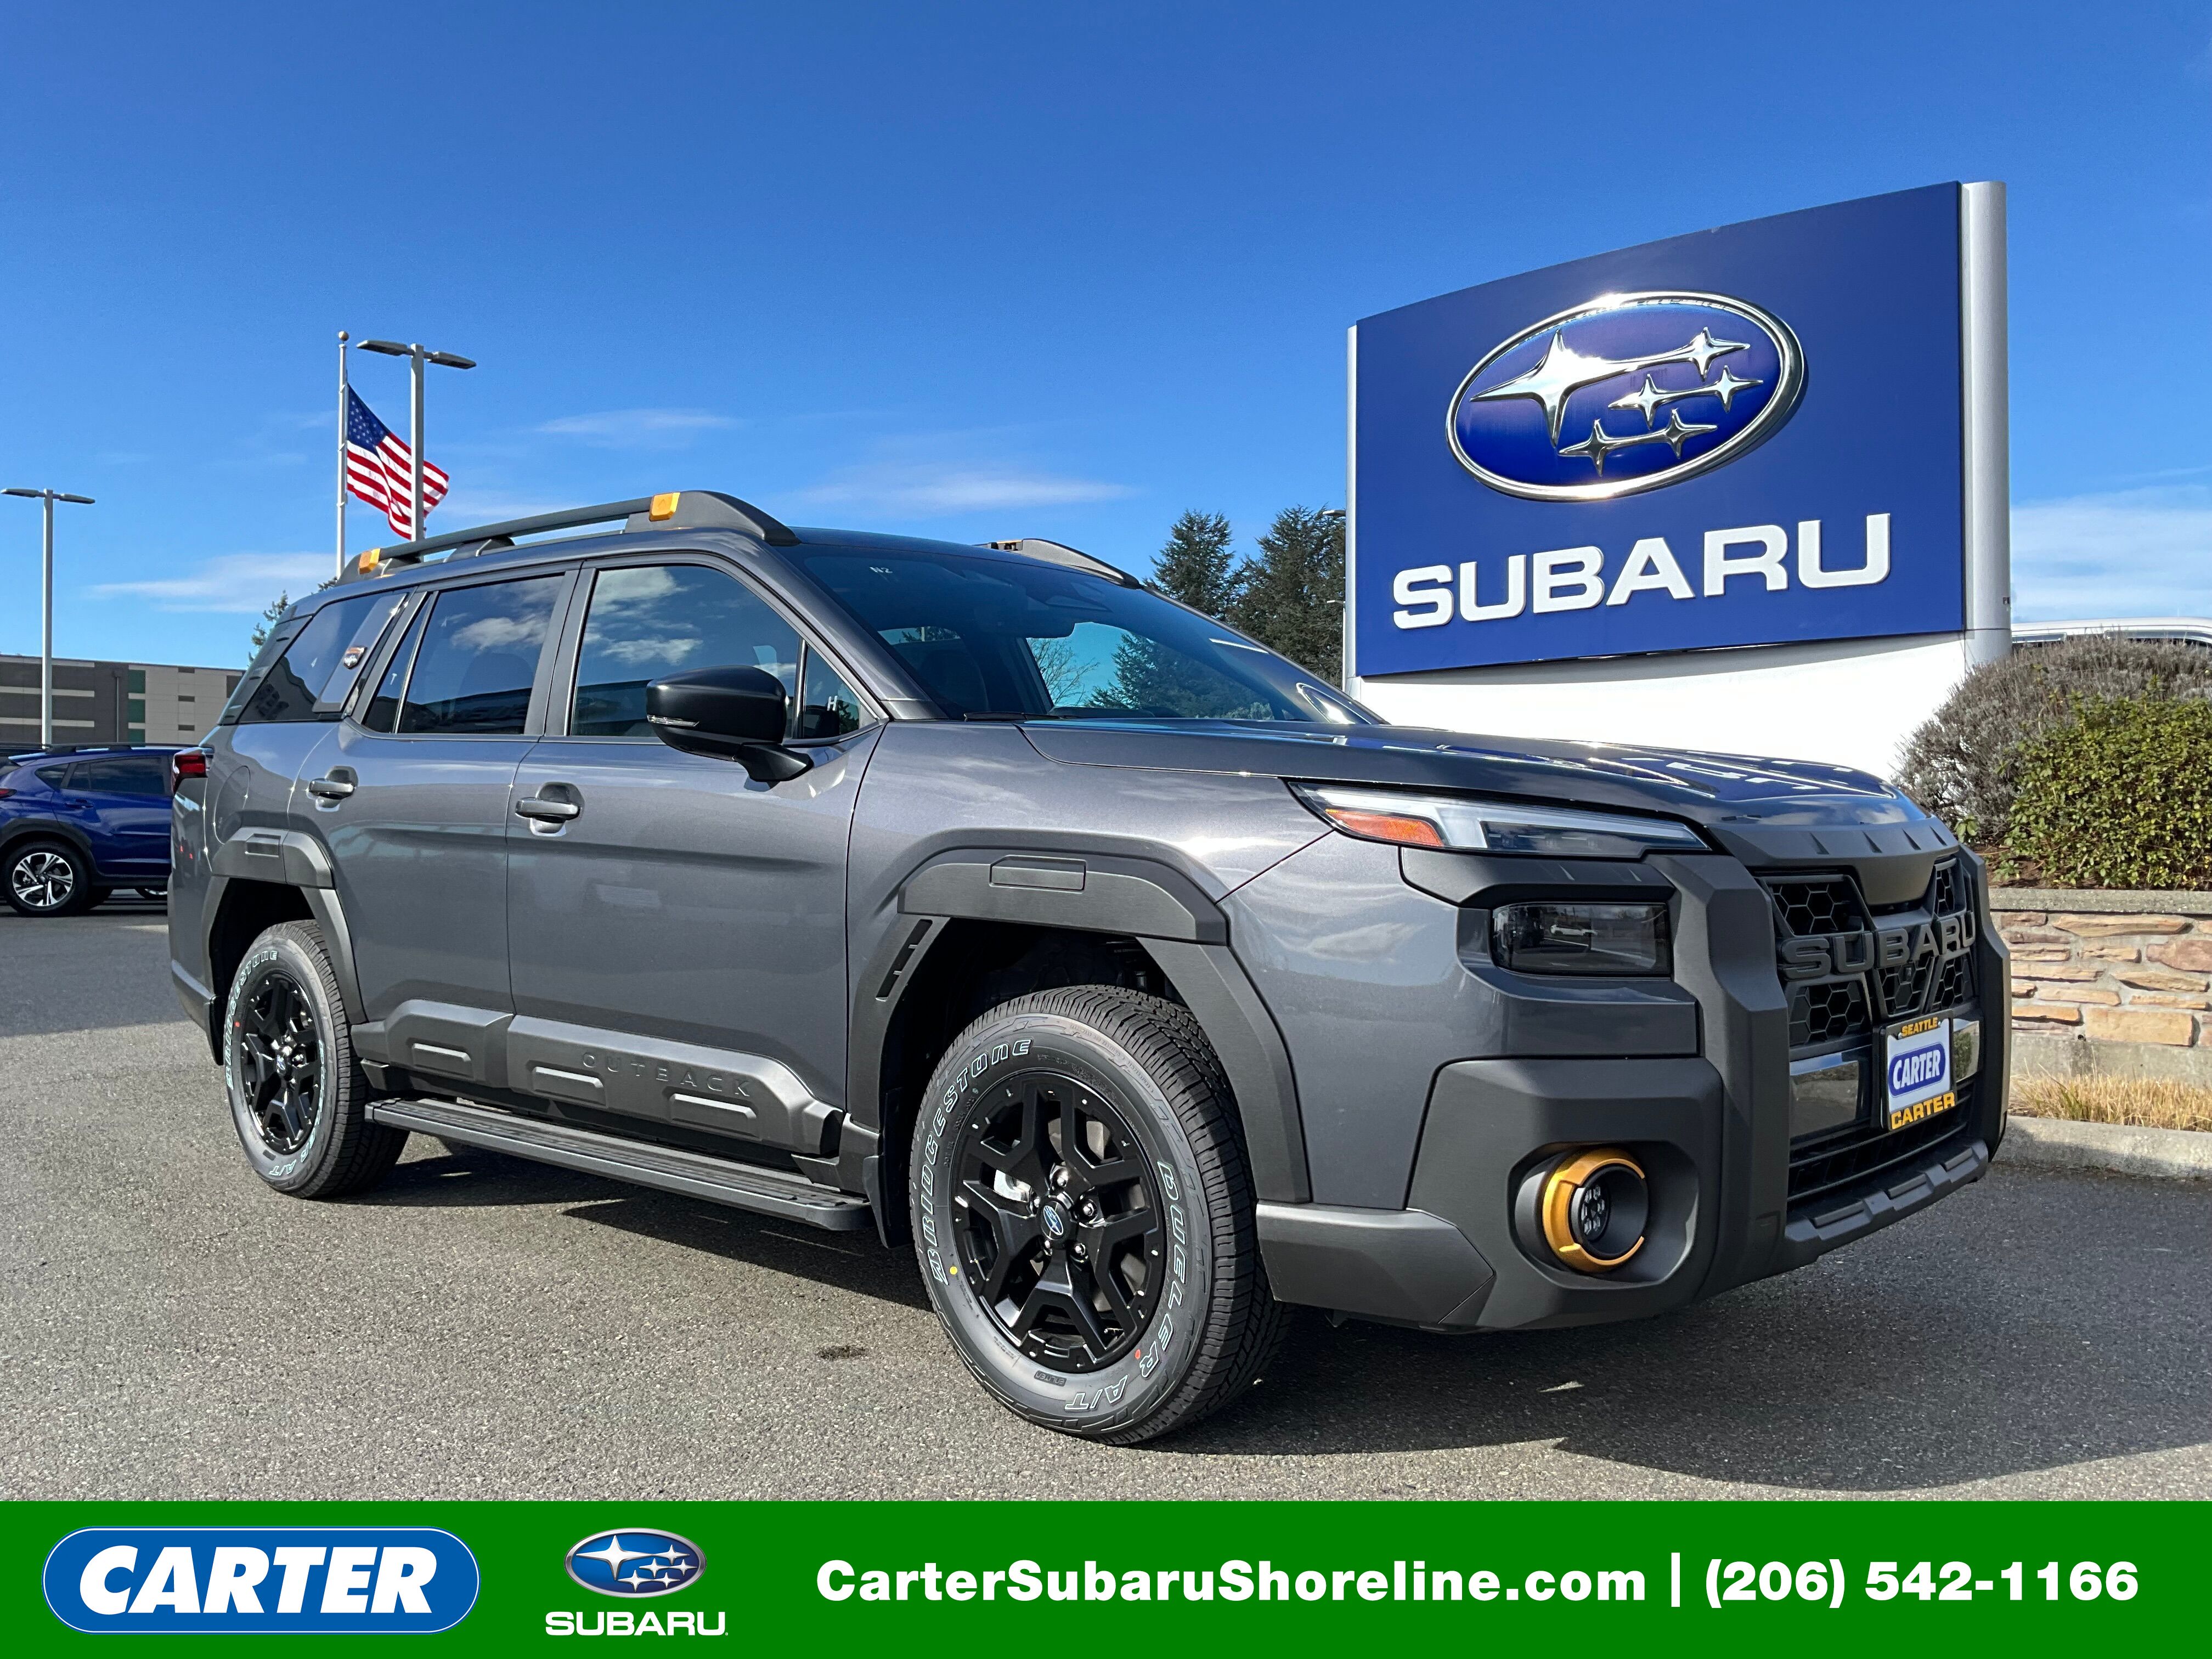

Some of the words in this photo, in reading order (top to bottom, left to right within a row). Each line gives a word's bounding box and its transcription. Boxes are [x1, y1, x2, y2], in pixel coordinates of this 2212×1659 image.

[1392, 513, 1891, 629] SUBARU
[1779, 910, 1976, 980] SUBARU
[225, 950, 278, 1090] BRIDGESTONE
[1901, 1017, 1939, 1037] SEATTLE
[583, 1053, 751, 1097] OUTBACK
[1892, 1049, 1942, 1090] CARTER
[1891, 1091, 1956, 1130] CARTER
[921, 1039, 1031, 1285] BRIDGESTONE
[1139, 1160, 1187, 1378] DUELER
[1064, 1374, 1129, 1411] A/T
